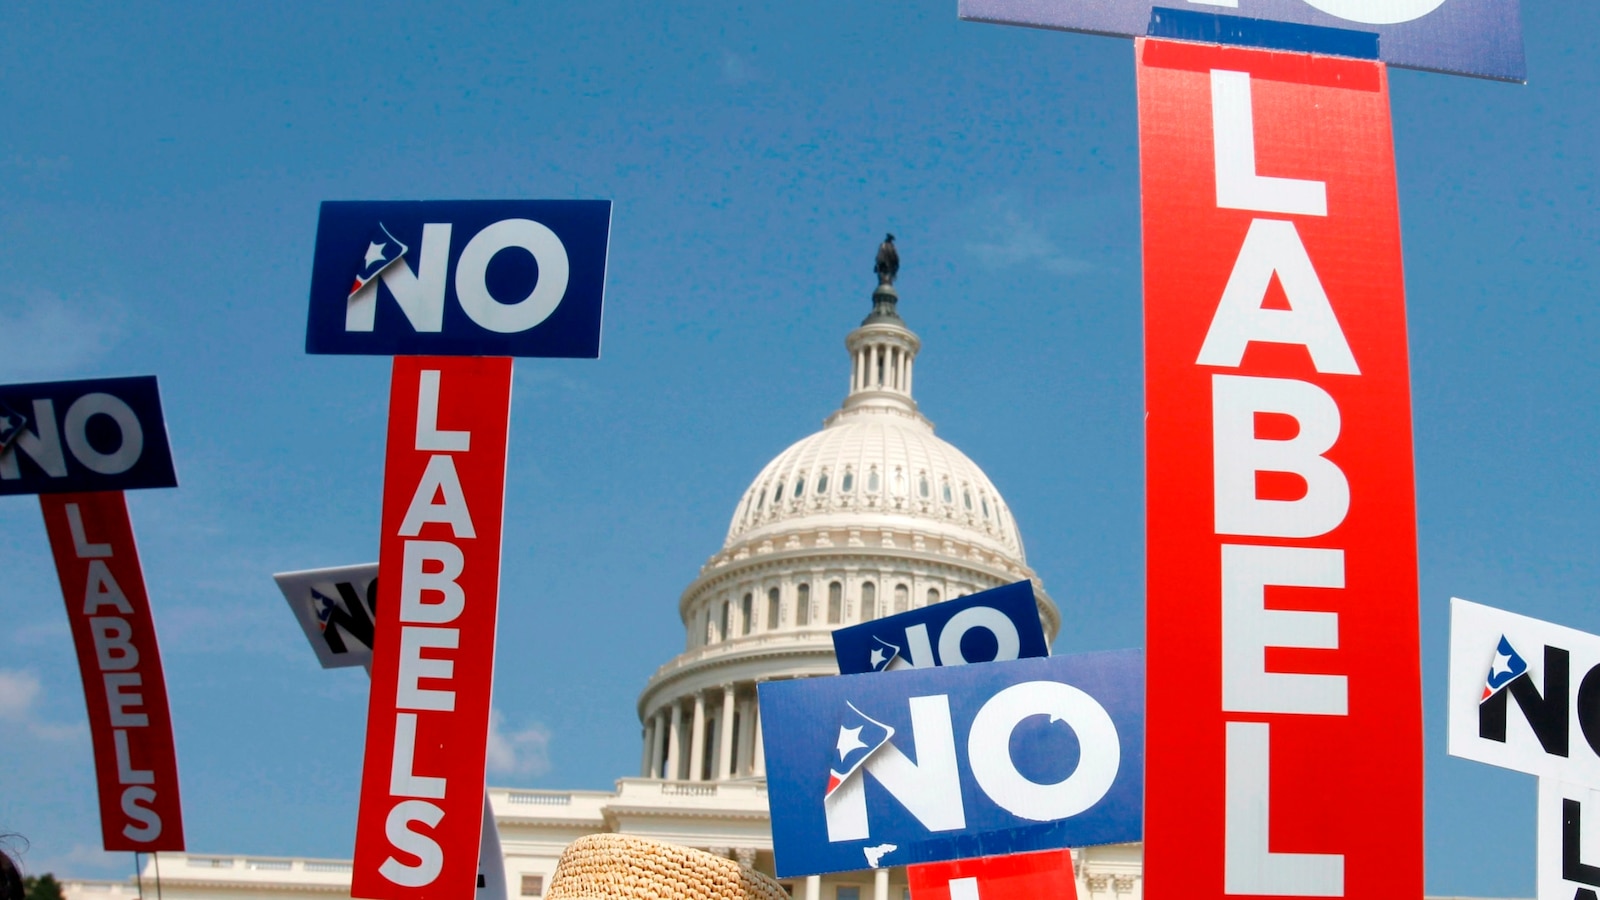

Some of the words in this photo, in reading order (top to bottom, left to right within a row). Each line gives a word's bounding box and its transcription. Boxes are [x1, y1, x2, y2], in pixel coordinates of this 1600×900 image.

[345, 218, 570, 333] NO
[0, 392, 144, 480] NO
[65, 503, 163, 843] LABELS
[311, 577, 379, 654] N
[378, 369, 477, 888] LABELS
[1479, 634, 1600, 759] N
[823, 680, 1121, 842] NO
